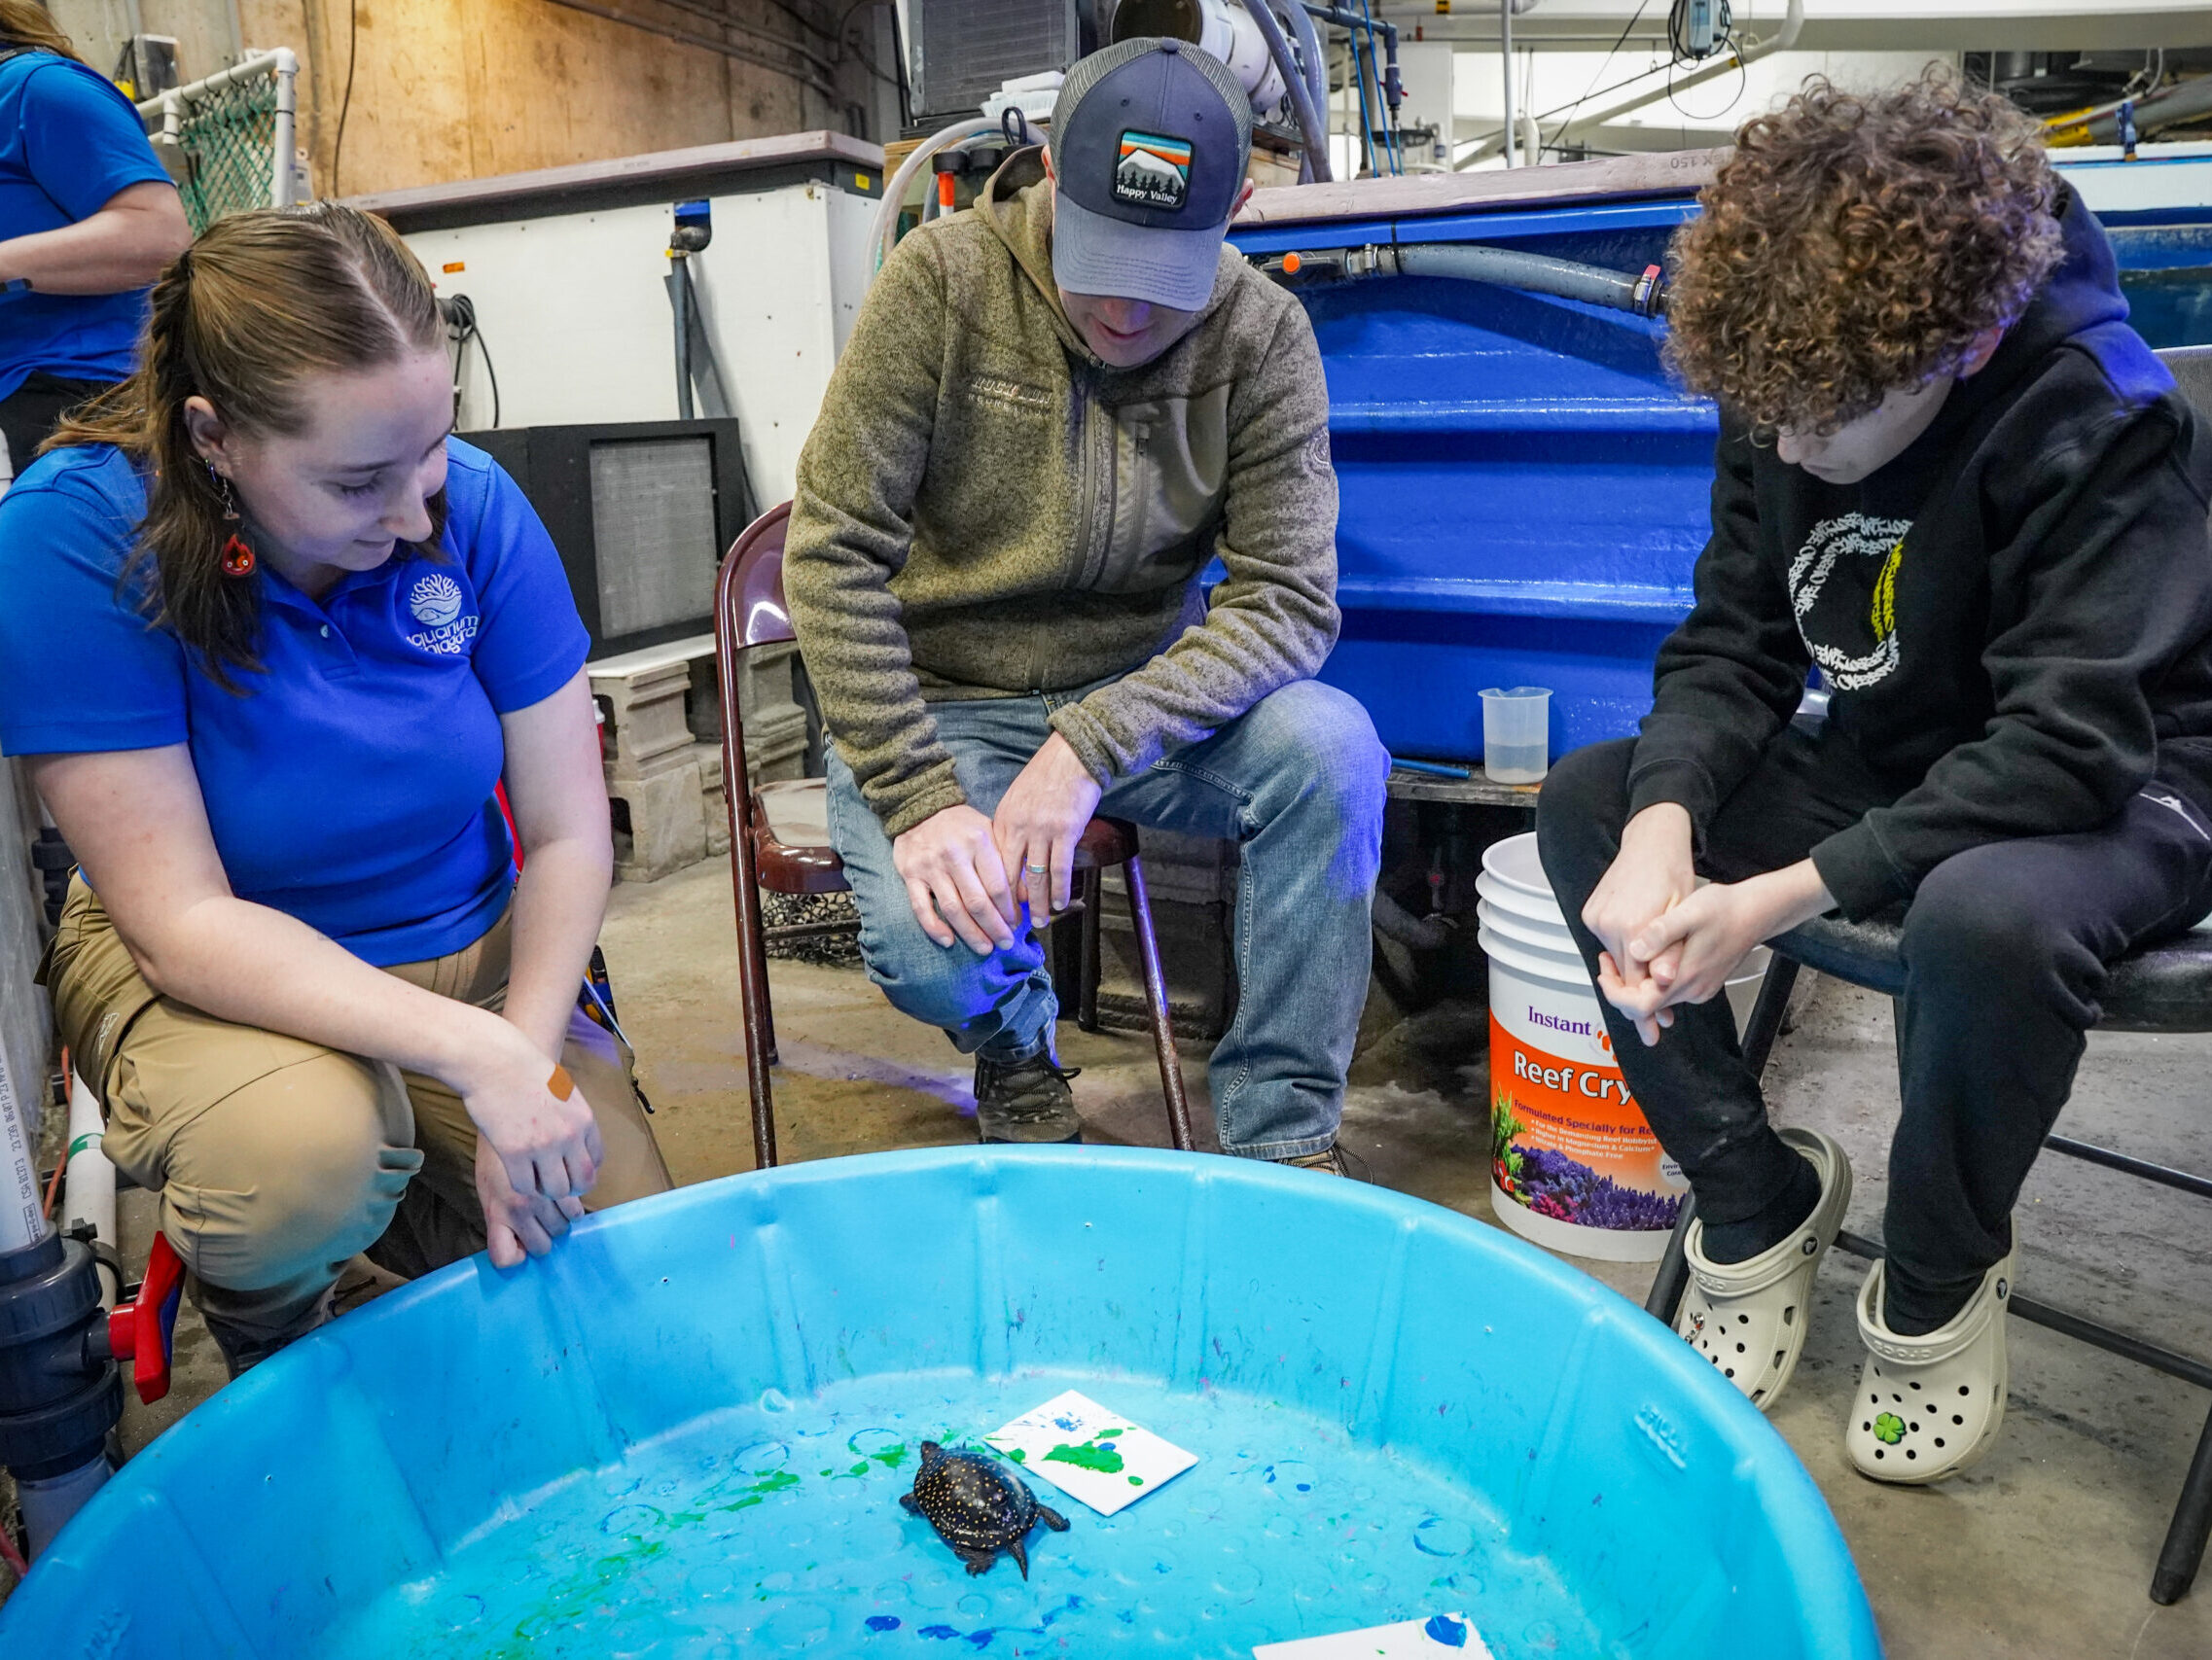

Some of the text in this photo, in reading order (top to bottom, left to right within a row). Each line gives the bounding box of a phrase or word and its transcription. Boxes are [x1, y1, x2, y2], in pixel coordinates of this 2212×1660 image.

[1670, 157, 1696, 169] 150
[1117, 184, 1178, 205] Happy Valley
[1527, 1006, 1591, 1036] Instant
[1514, 1049, 1632, 1106] Reef Cry
[1514, 1100, 1563, 1125] Formulated
[1565, 1118, 1616, 1136] Specially
[1619, 1125, 1635, 1136] for
[1535, 1120, 1658, 1147] For the Demanding Reef Hobbyist
[1535, 1129, 1556, 1141] Higher
[1566, 1138, 1610, 1151] Magnesium
[1535, 1136, 1557, 1148] Nitrate
[1565, 1146, 1604, 1158] Phosphate
[1606, 1150, 1623, 1159] Free
[19, 1183, 33, 1200] CSA
